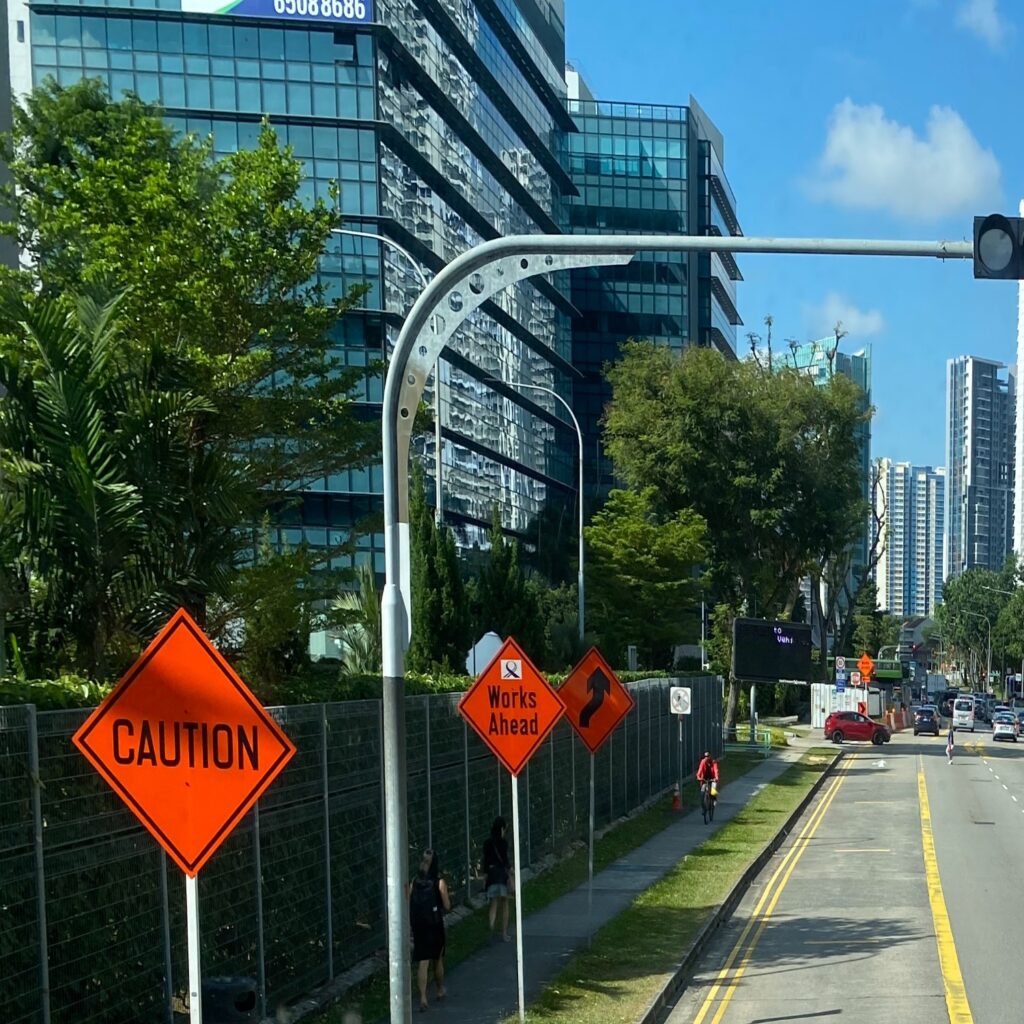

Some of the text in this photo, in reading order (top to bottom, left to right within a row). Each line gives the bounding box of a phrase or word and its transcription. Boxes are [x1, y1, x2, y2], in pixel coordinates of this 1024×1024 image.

[487, 684, 537, 709] Works
[488, 711, 539, 736] Ahead
[112, 718, 260, 771] CAUTION
